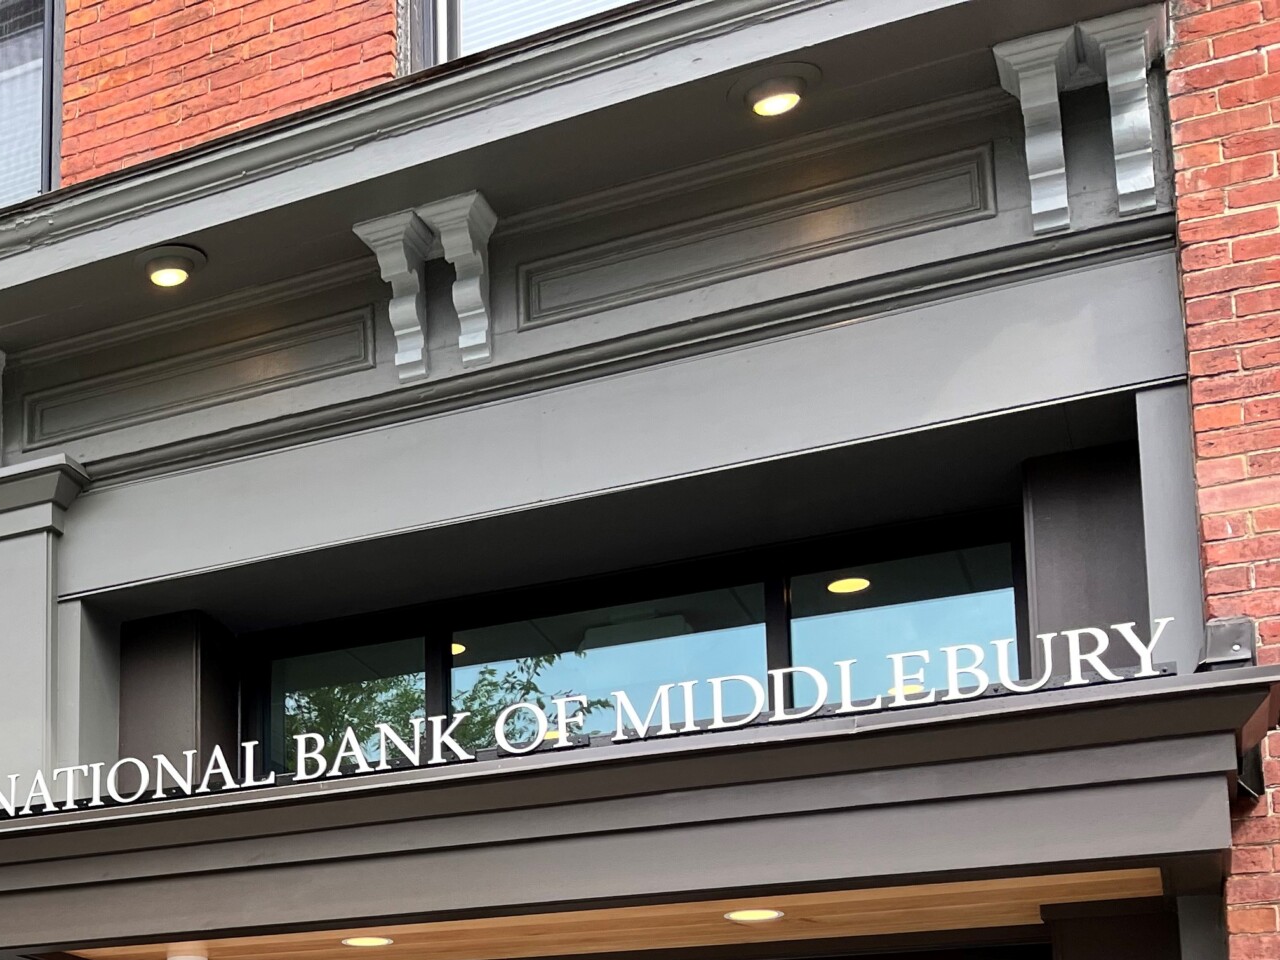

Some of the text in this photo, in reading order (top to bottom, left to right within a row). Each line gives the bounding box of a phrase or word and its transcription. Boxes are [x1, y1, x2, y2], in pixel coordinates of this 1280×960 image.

[293, 711, 475, 780] BANK
[494, 695, 587, 753] OF
[611, 617, 1175, 742] MIDDLEBURY
